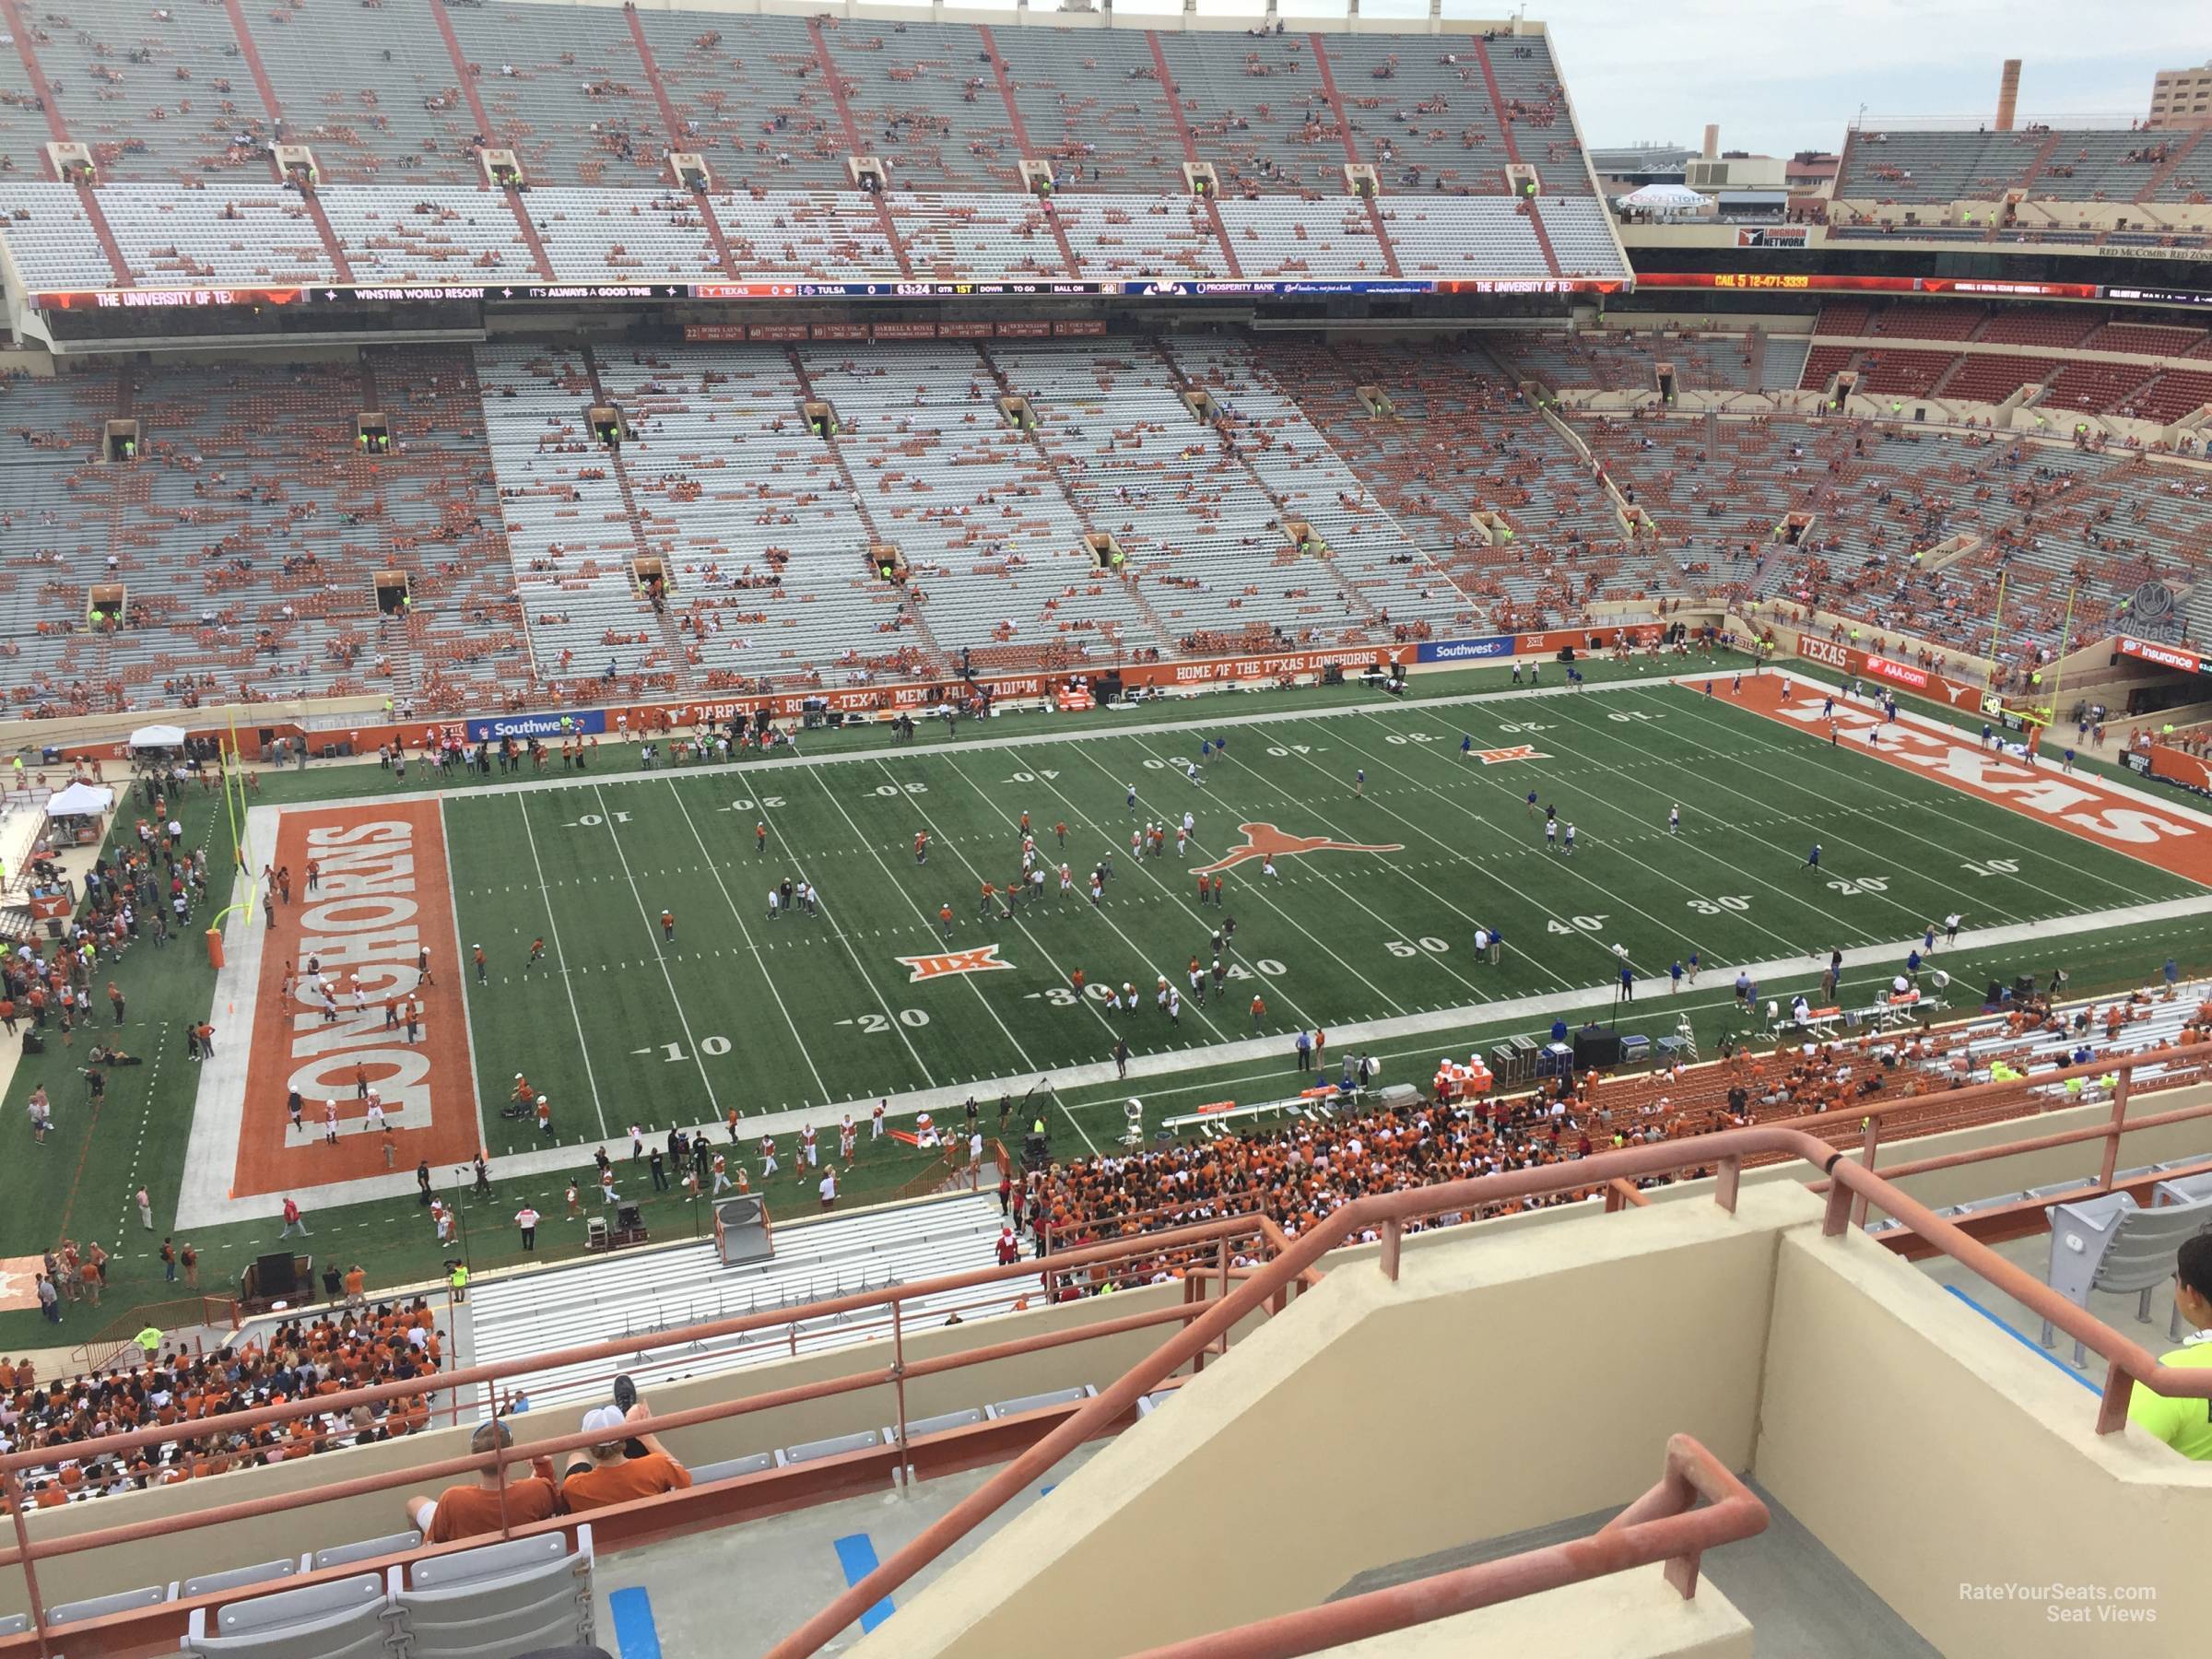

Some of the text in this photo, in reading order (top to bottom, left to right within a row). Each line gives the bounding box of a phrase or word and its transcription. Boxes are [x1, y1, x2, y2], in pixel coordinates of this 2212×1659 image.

[1765, 229, 1806, 237] LONGHORN
[1764, 238, 1806, 247] NETWORK
[1206, 283, 1276, 291] PROSPERITY BANK
[1476, 282, 1493, 292] THE
[1494, 281, 1544, 292] UNIVERSITY
[1545, 281, 1557, 292] OF
[1715, 275, 1735, 286] CALL
[354, 288, 485, 300] WINSTAR WORLD RESORT
[529, 287, 652, 297] IT'S ALWAYS A GOOD TIME
[719, 286, 779, 295] TEXAS 0
[818, 286, 876, 295] TULSA 0
[897, 284, 930, 295] 63:24
[956, 285, 972, 293] 1ST
[96, 292, 120, 307] THE
[124, 291, 192, 307] UNIVERSITY
[195, 290, 210, 305] OF
[686, 329, 698, 338] 22
[814, 328, 823, 336] 10
[939, 326, 949, 335] 20
[998, 325, 1007, 334] 34
[2115, 617, 2173, 640] Allstate
[1436, 643, 1492, 657] Southwest
[1802, 637, 1847, 667] TEXAS
[2142, 645, 2193, 668] Insurance
[1177, 666, 1211, 680] HOME
[1236, 662, 1260, 675] THE
[1265, 659, 1304, 674] TEXAS
[1309, 652, 1378, 669] LONGHORNS
[1884, 664, 1924, 685] AAA.com
[1606, 711, 1653, 723] 10
[494, 718, 574, 735] Southwe
[1499, 722, 1547, 733] 20
[1384, 732, 1433, 745] 30
[1266, 744, 1312, 757] 40
[1012, 769, 1061, 783] 40
[1774, 699, 2197, 843] TEXAS
[876, 782, 928, 797] 30
[732, 796, 786, 811] 20
[579, 811, 634, 827] 10
[1961, 860, 2019, 877] 10
[1827, 877, 1888, 896] 20
[1687, 896, 1750, 915] 30
[1547, 919, 1603, 935] 40
[1384, 936, 1450, 958] 50
[1227, 959, 1288, 981] 40
[284, 820, 432, 1148] LONGHORNS
[856, 1008, 931, 1033] 20
[659, 1036, 732, 1062] 10
